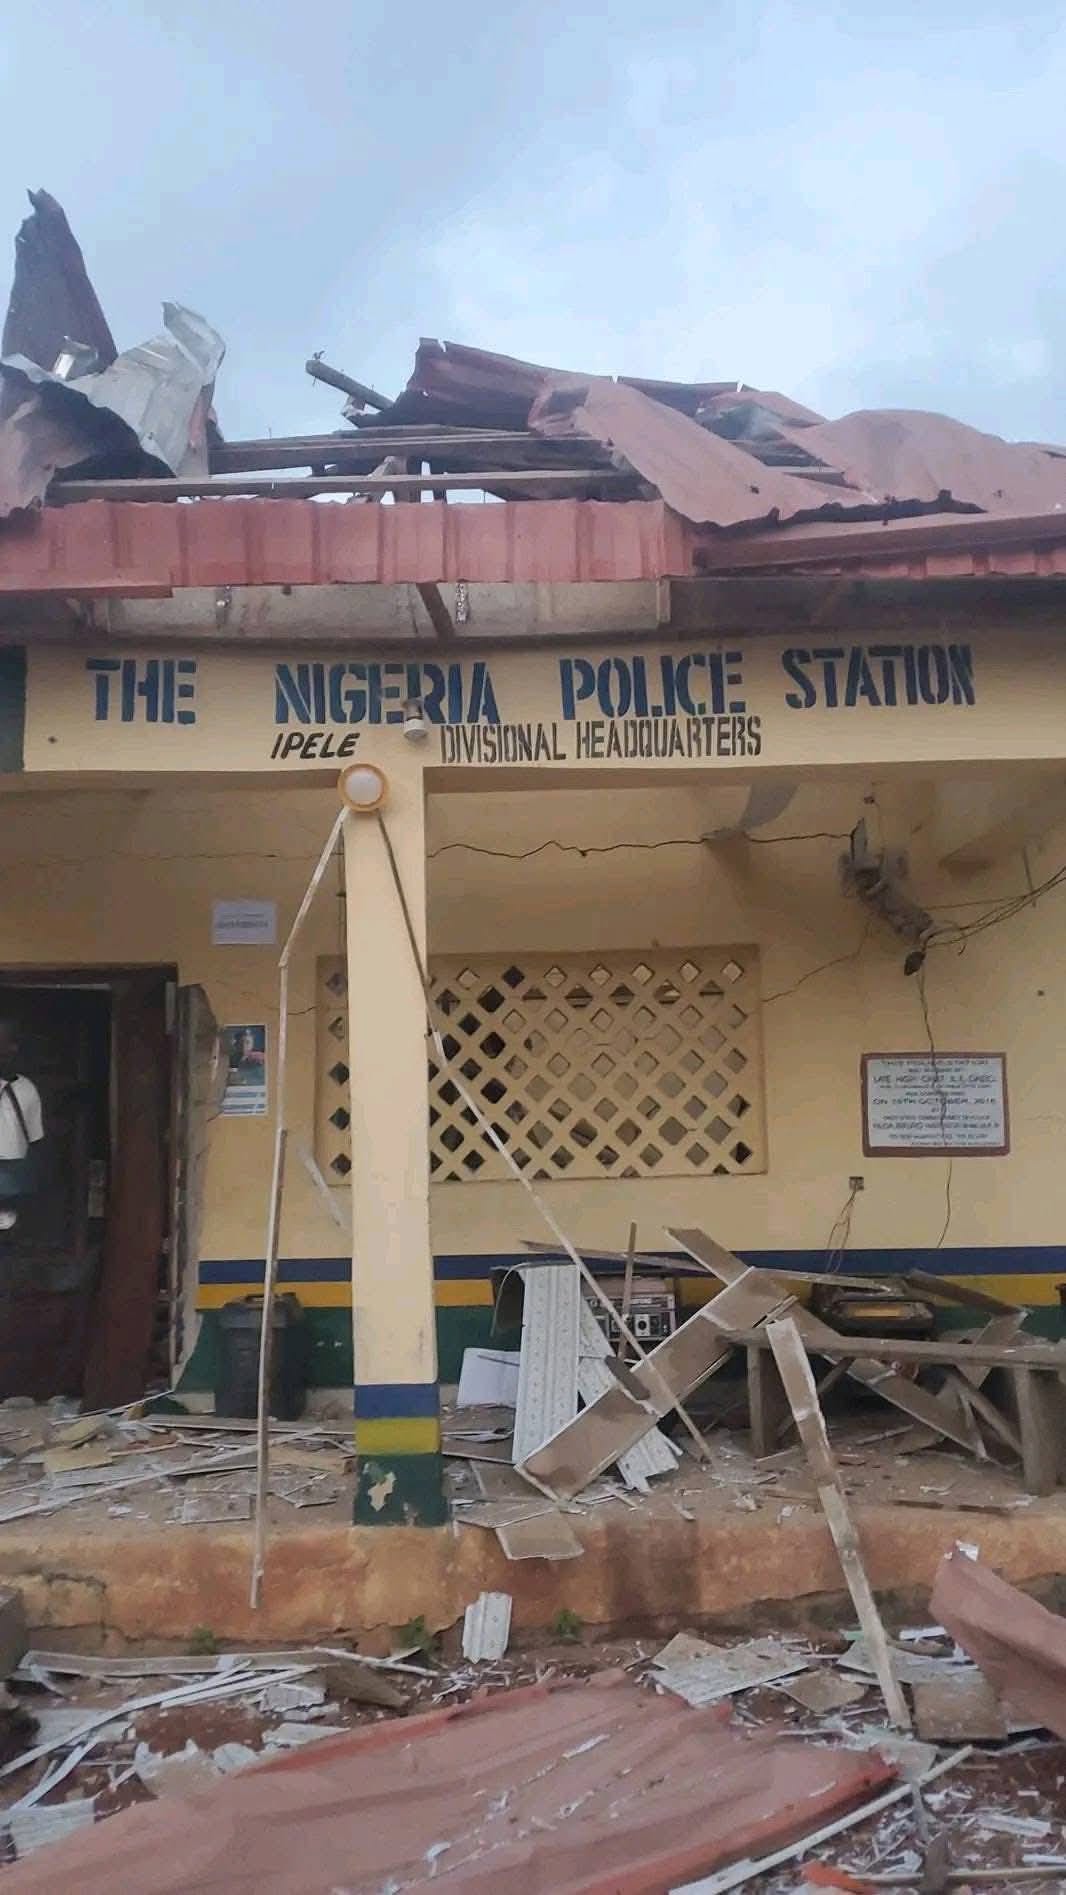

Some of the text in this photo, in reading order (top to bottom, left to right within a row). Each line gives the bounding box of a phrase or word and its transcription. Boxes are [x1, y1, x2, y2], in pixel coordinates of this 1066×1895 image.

[86, 644, 975, 724] THE NIGERIA POLICE STATION
[270, 716, 762, 764] IPELE DIVISIONAL HEADQUARTERS
